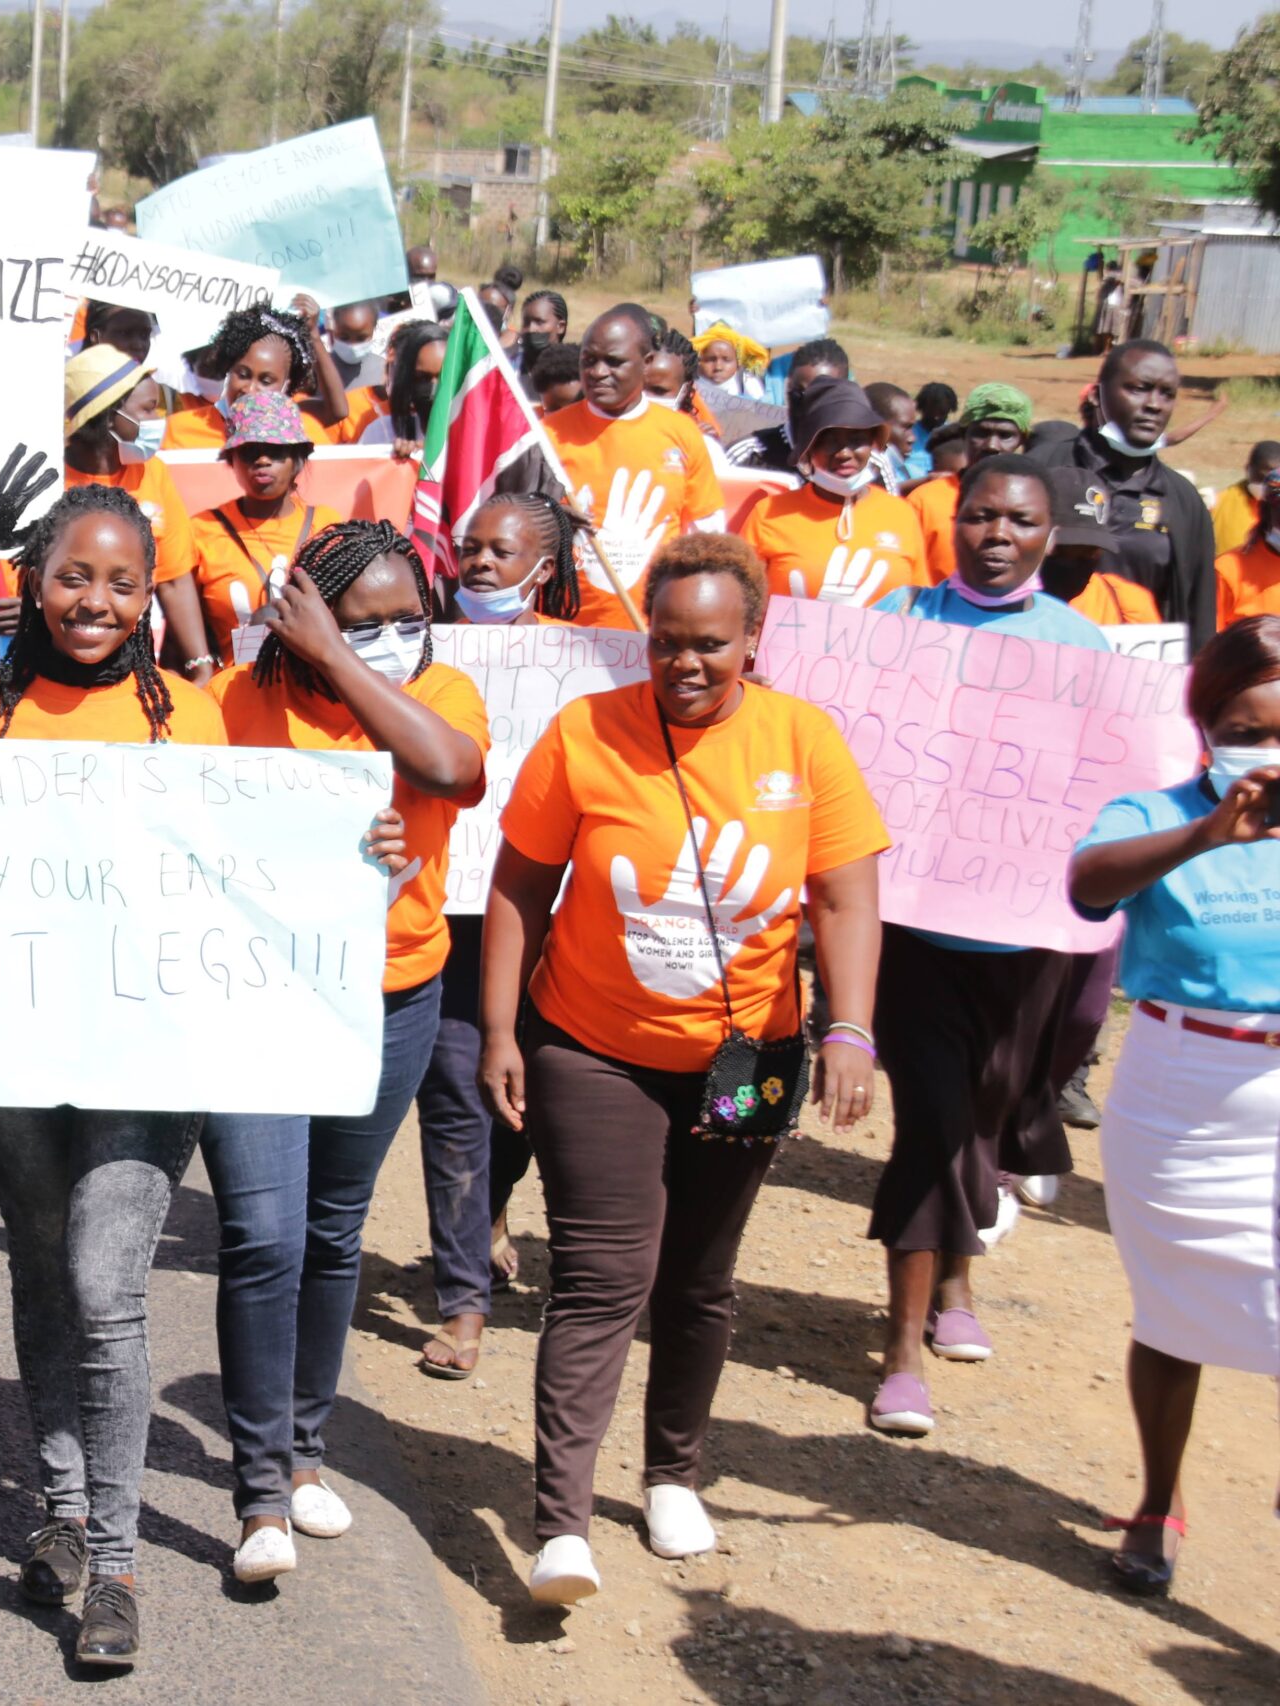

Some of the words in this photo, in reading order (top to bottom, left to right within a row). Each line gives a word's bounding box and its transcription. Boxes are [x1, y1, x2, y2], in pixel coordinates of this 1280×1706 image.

[765, 601, 806, 649] A
[824, 604, 1035, 692] WORLD
[764, 648, 1036, 745] VIOLENCE
[1076, 706, 1130, 766] IS
[199, 753, 391, 805] BETWEEN
[160, 852, 277, 898] EARS
[1194, 889, 1259, 906] Working
[1200, 910, 1259, 926] Gender
[113, 924, 349, 1001] LEGS!!!
[636, 944, 672, 958] WOMEN
[676, 950, 695, 959] AND
